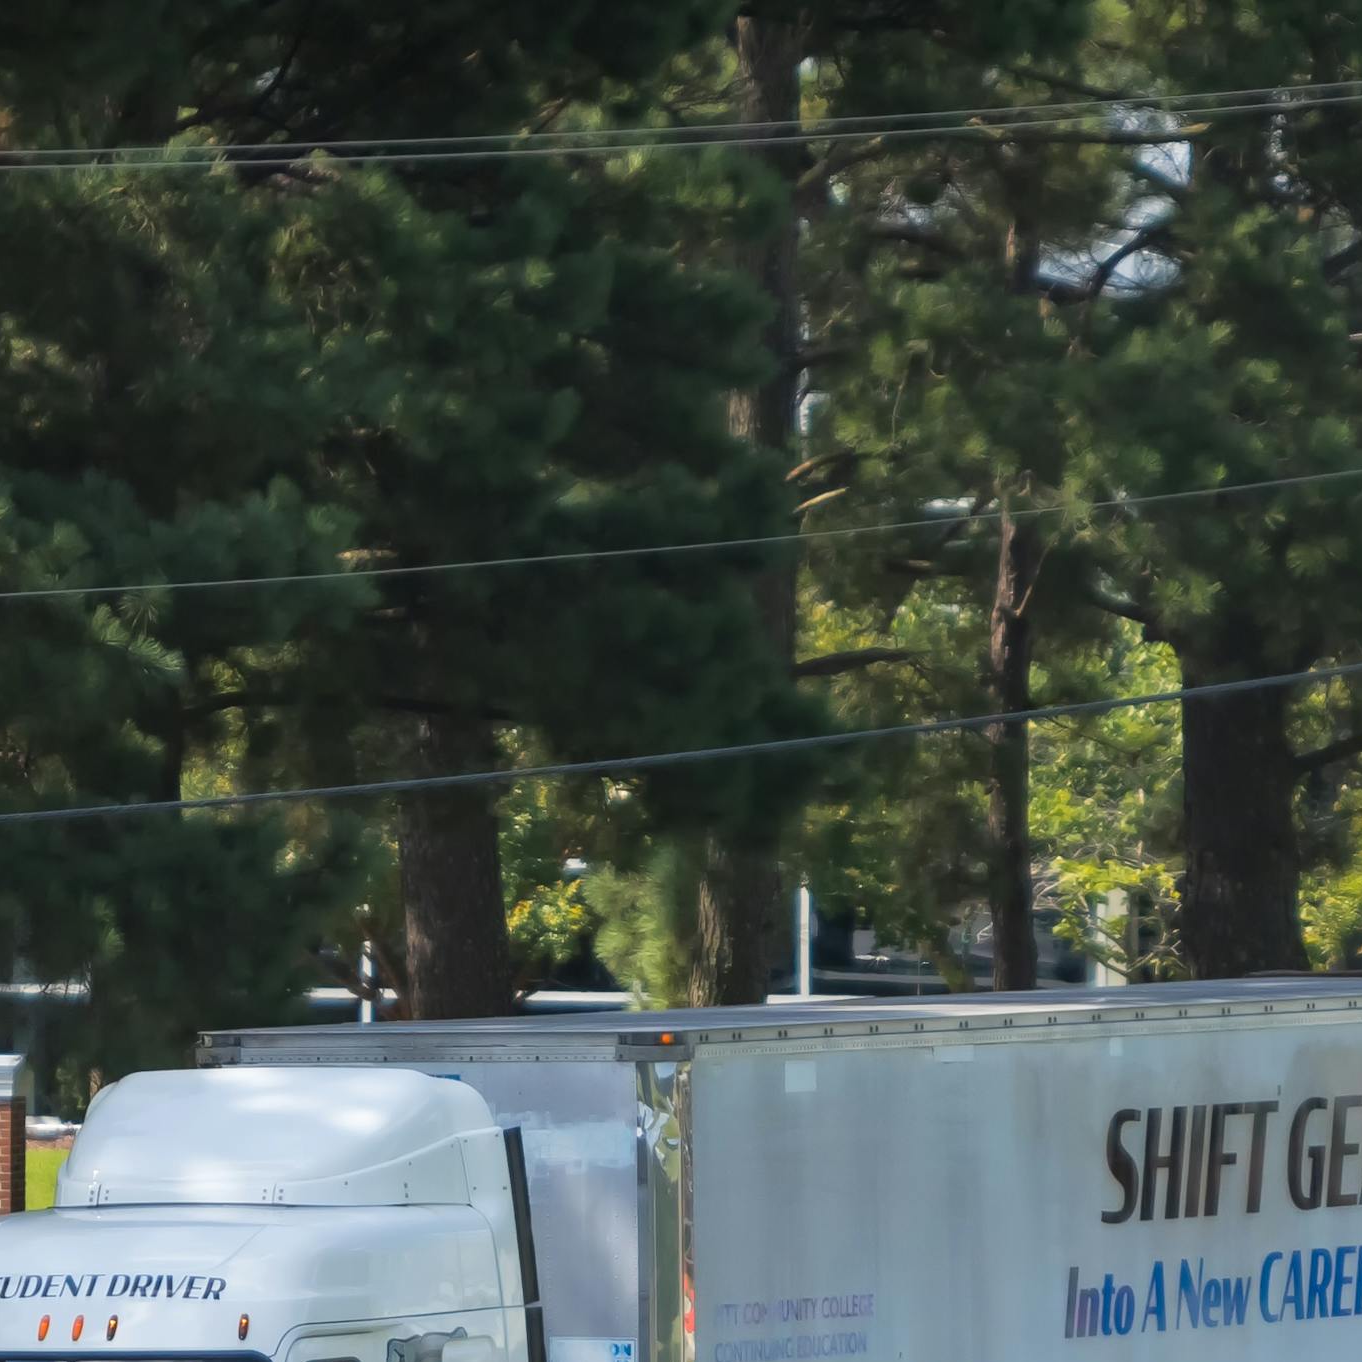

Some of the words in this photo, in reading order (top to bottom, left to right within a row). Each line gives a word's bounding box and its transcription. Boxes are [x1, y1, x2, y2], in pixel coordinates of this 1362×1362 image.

[1100, 1100, 1280, 1225] SHIFT
[105, 1274, 227, 1301] DRIVER
[1064, 1266, 1136, 1339] Into
[1140, 1260, 1167, 1333] A
[1175, 1257, 1252, 1330] New
[742, 1298, 820, 1325] COUNITY
[821, 1293, 875, 1319] COLLEGE
[796, 1331, 868, 1359] EDUCATION
